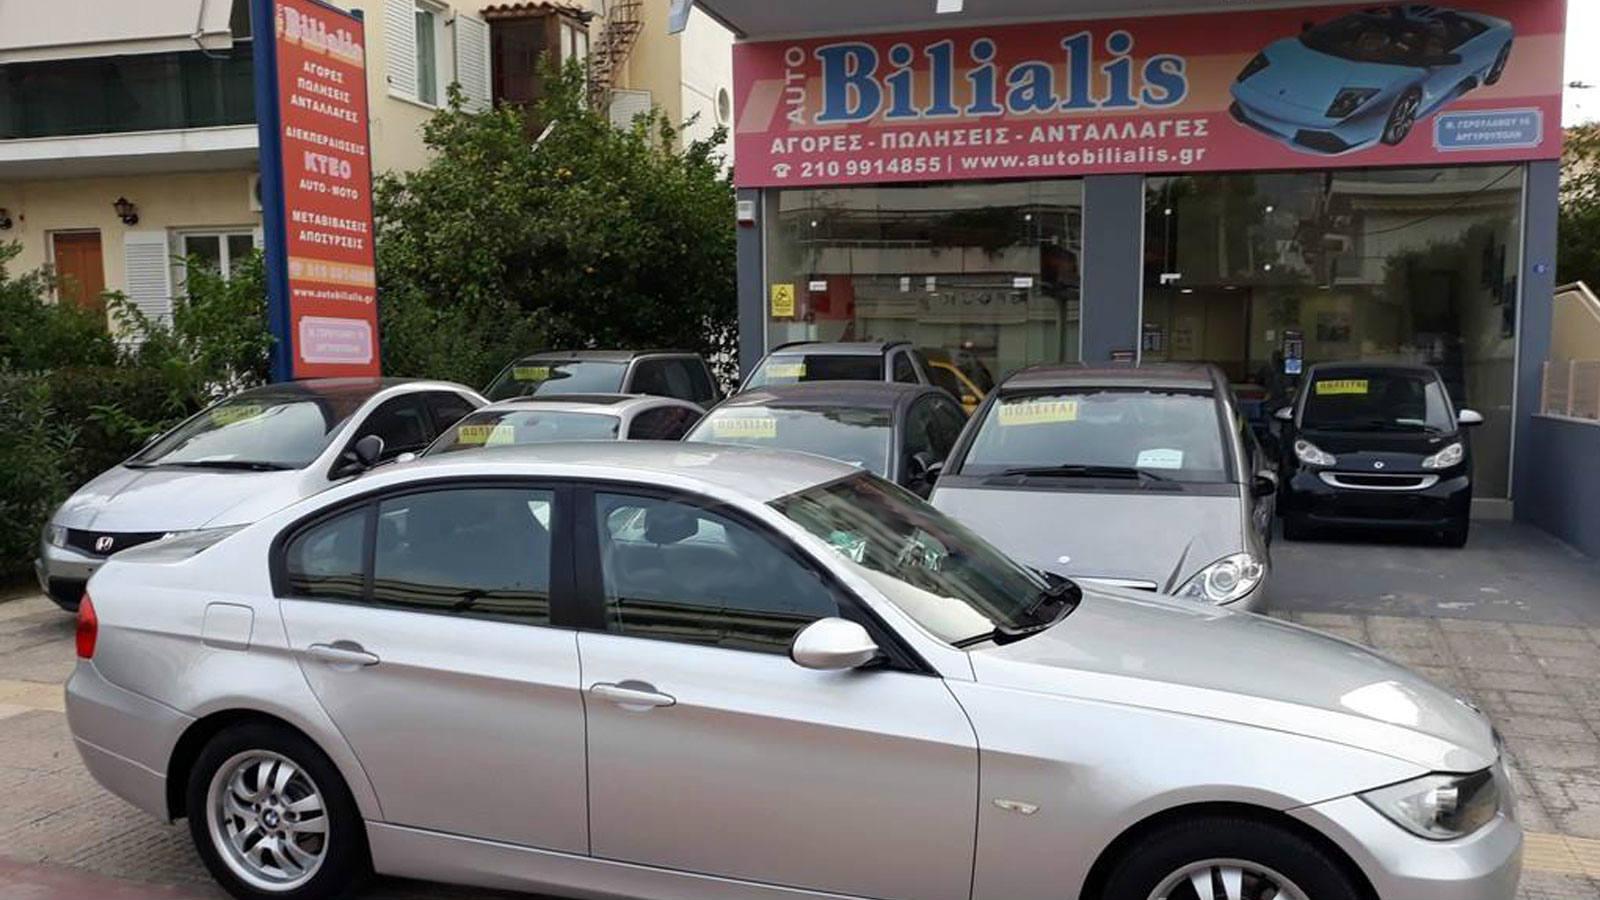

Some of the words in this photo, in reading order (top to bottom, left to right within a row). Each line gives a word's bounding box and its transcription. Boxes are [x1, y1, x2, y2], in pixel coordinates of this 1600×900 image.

[303, 60, 343, 84] ΑΓΟΡΕΣ
[784, 46, 807, 124] AUTO
[814, 29, 1189, 124] Bilialis
[297, 76, 350, 104] ΠΩΛΗΣΕΙΣ
[290, 94, 359, 124] ΑΝΤΑΛΛΑΓΕΣ
[770, 133, 862, 154] ΑΓΟΡΕΣ
[881, 127, 1010, 150] ΠΩΛΗΣΕΙΣ
[1029, 119, 1209, 143] ΑΝΤΑΛΛΑΓΕΣ
[801, 162, 839, 178] 210
[846, 157, 941, 176] 9914855
[961, 146, 1206, 169] www.autobilialis.gr
[299, 179, 326, 193] AUTO
[292, 210, 368, 233] ΜΕΤΑΒΙΒΑΣΕΙΣ
